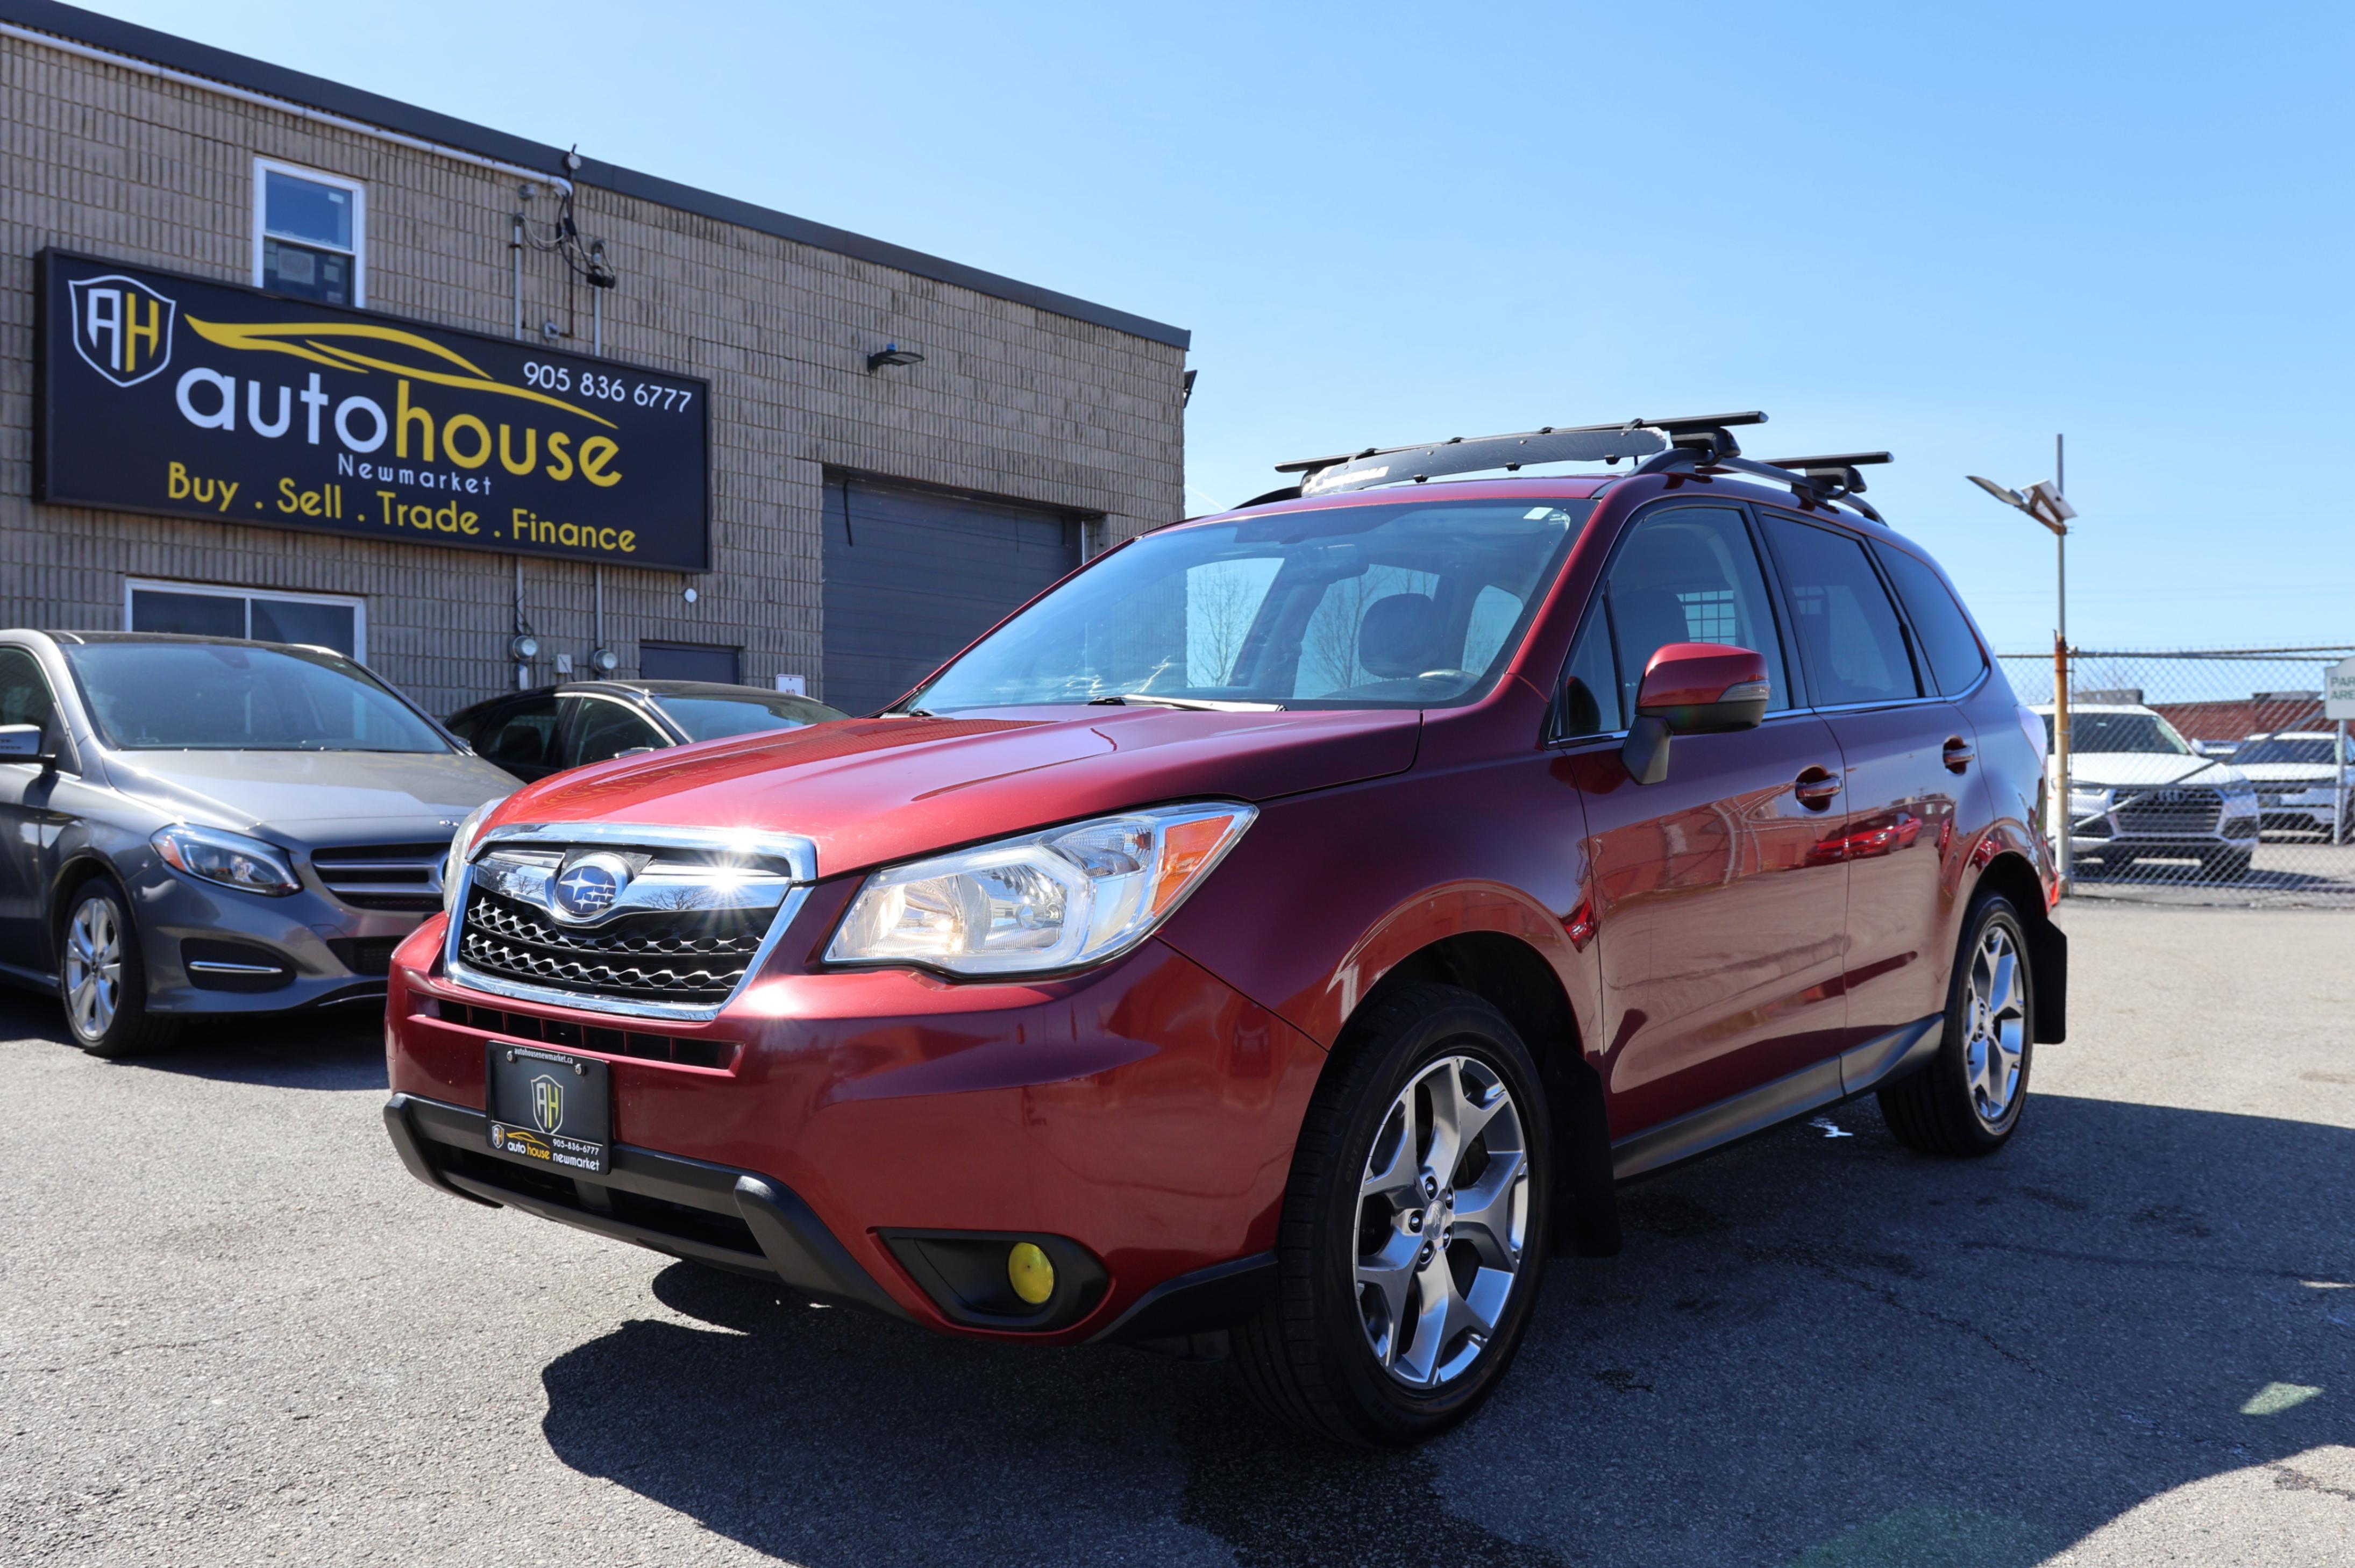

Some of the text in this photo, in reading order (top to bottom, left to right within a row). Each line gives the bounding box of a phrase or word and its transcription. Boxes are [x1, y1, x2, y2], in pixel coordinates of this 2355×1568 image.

[87, 289, 159, 372] AH
[523, 361, 692, 413] 905 836 6777
[176, 367, 622, 487] autohouse
[338, 453, 491, 495] Newmarket
[168, 461, 637, 552] Buy Sell Trade Finance
[514, 1047, 573, 1064] autohousenewmarket.ca
[507, 1141, 600, 1171] auto house newmarket
[553, 1138, 599, 1156] 905-836-6777
